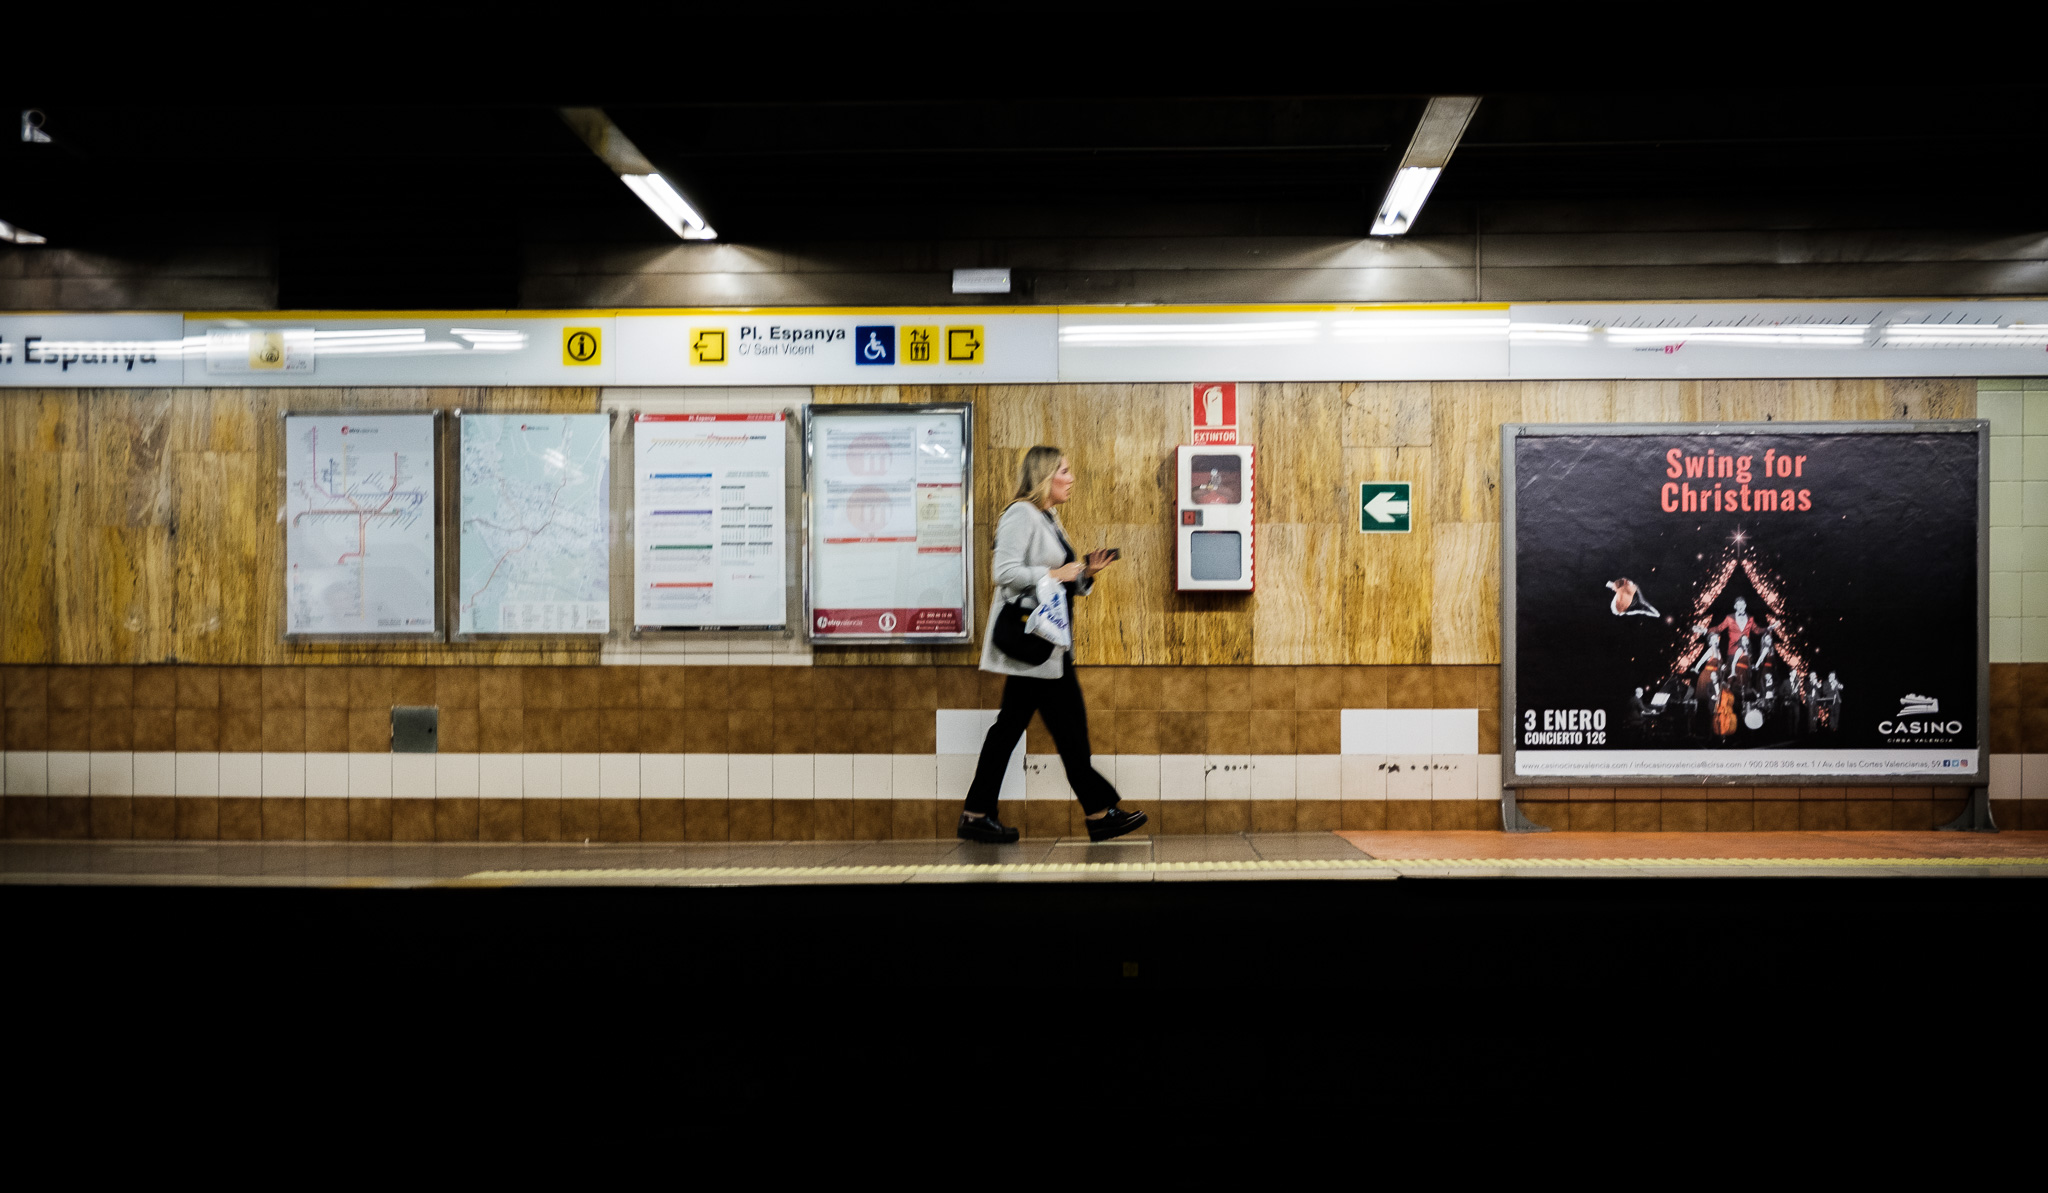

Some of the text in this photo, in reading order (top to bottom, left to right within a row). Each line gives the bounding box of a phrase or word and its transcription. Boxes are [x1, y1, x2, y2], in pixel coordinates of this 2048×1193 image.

[740, 326, 846, 343] Pl. Espanya
[739, 343, 815, 356] C/ Sant Vicent
[1194, 432, 1237, 442] EXTINTOR
[1666, 448, 1808, 484] Swing for
[1661, 482, 1813, 513] Christmas
[1524, 709, 1607, 731] 3 ENERO
[1878, 720, 1963, 735] CASINO
[1524, 731, 1583, 746] CONCIERTO
[1748, 760, 1763, 768] 900
[1834, 760, 1845, 768] de
[1847, 760, 1857, 768] las
[1858, 760, 1883, 768] Cortes
